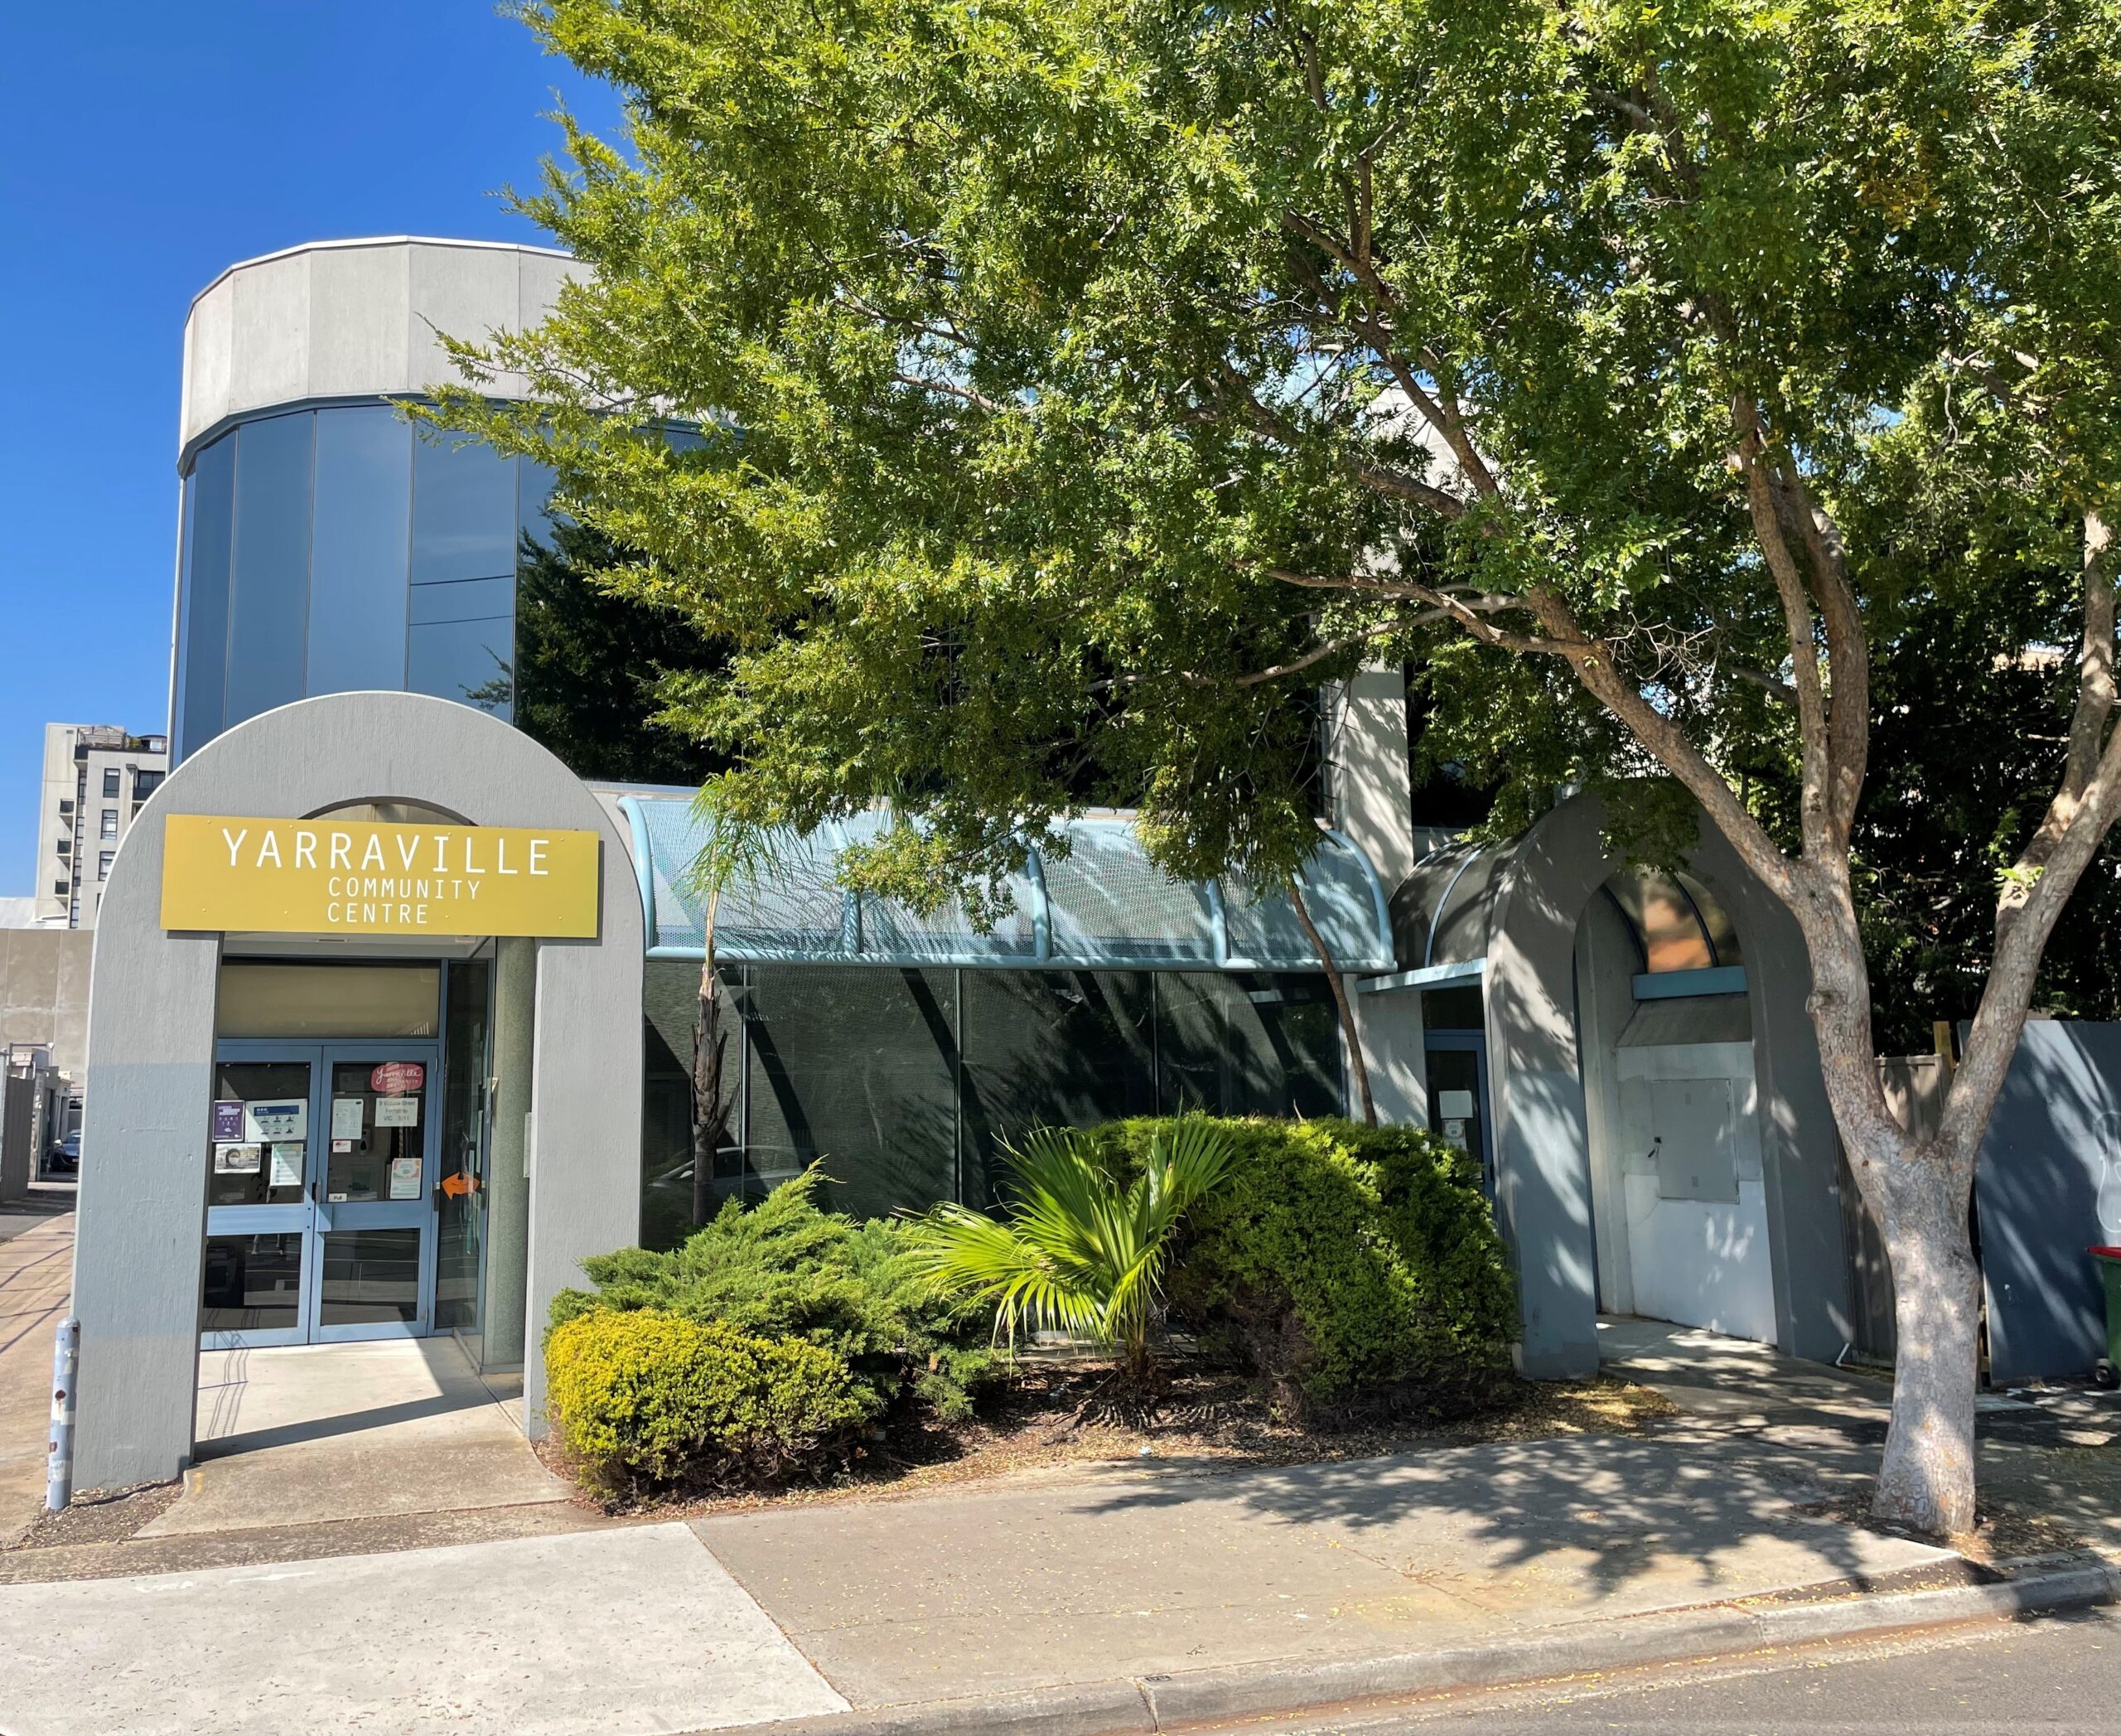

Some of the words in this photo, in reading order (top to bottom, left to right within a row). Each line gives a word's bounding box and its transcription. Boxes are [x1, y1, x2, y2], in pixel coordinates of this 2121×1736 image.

[222, 829, 549, 875] YARRAVILLE
[328, 877, 481, 899] COMMUNITY
[327, 902, 428, 924] CENTRE
